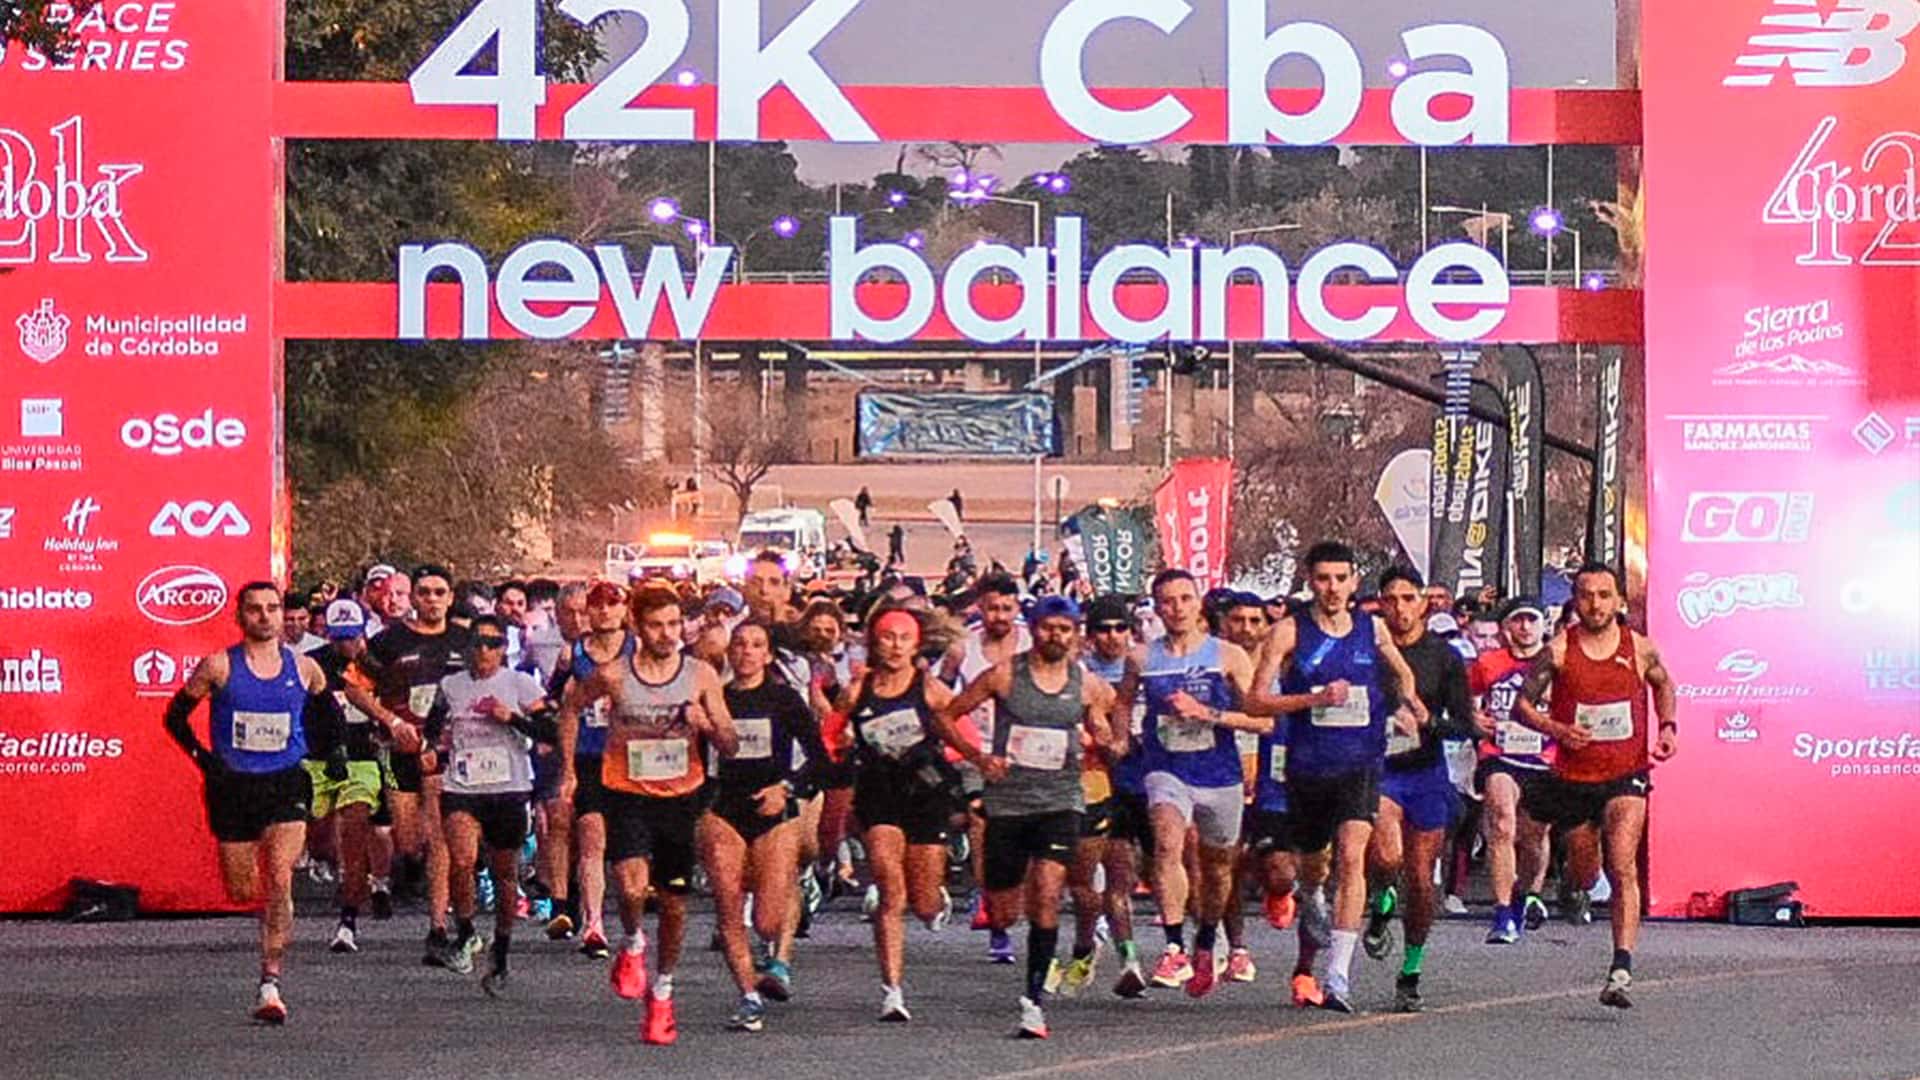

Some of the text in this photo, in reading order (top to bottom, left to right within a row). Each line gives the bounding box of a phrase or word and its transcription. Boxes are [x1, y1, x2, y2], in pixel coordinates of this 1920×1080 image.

[409, 0, 1509, 144] 42K Cba
[399, 215, 1510, 342] new balance
[85, 314, 247, 336] Municipalidad
[1744, 299, 1829, 337] Sierra
[85, 337, 219, 356] de Córdoba
[1787, 322, 1844, 346] Padres
[121, 408, 247, 455] osde
[1683, 422, 1811, 439] FARMACIAS
[149, 501, 251, 537] ACA
[139, 584, 222, 606] ARCOR
